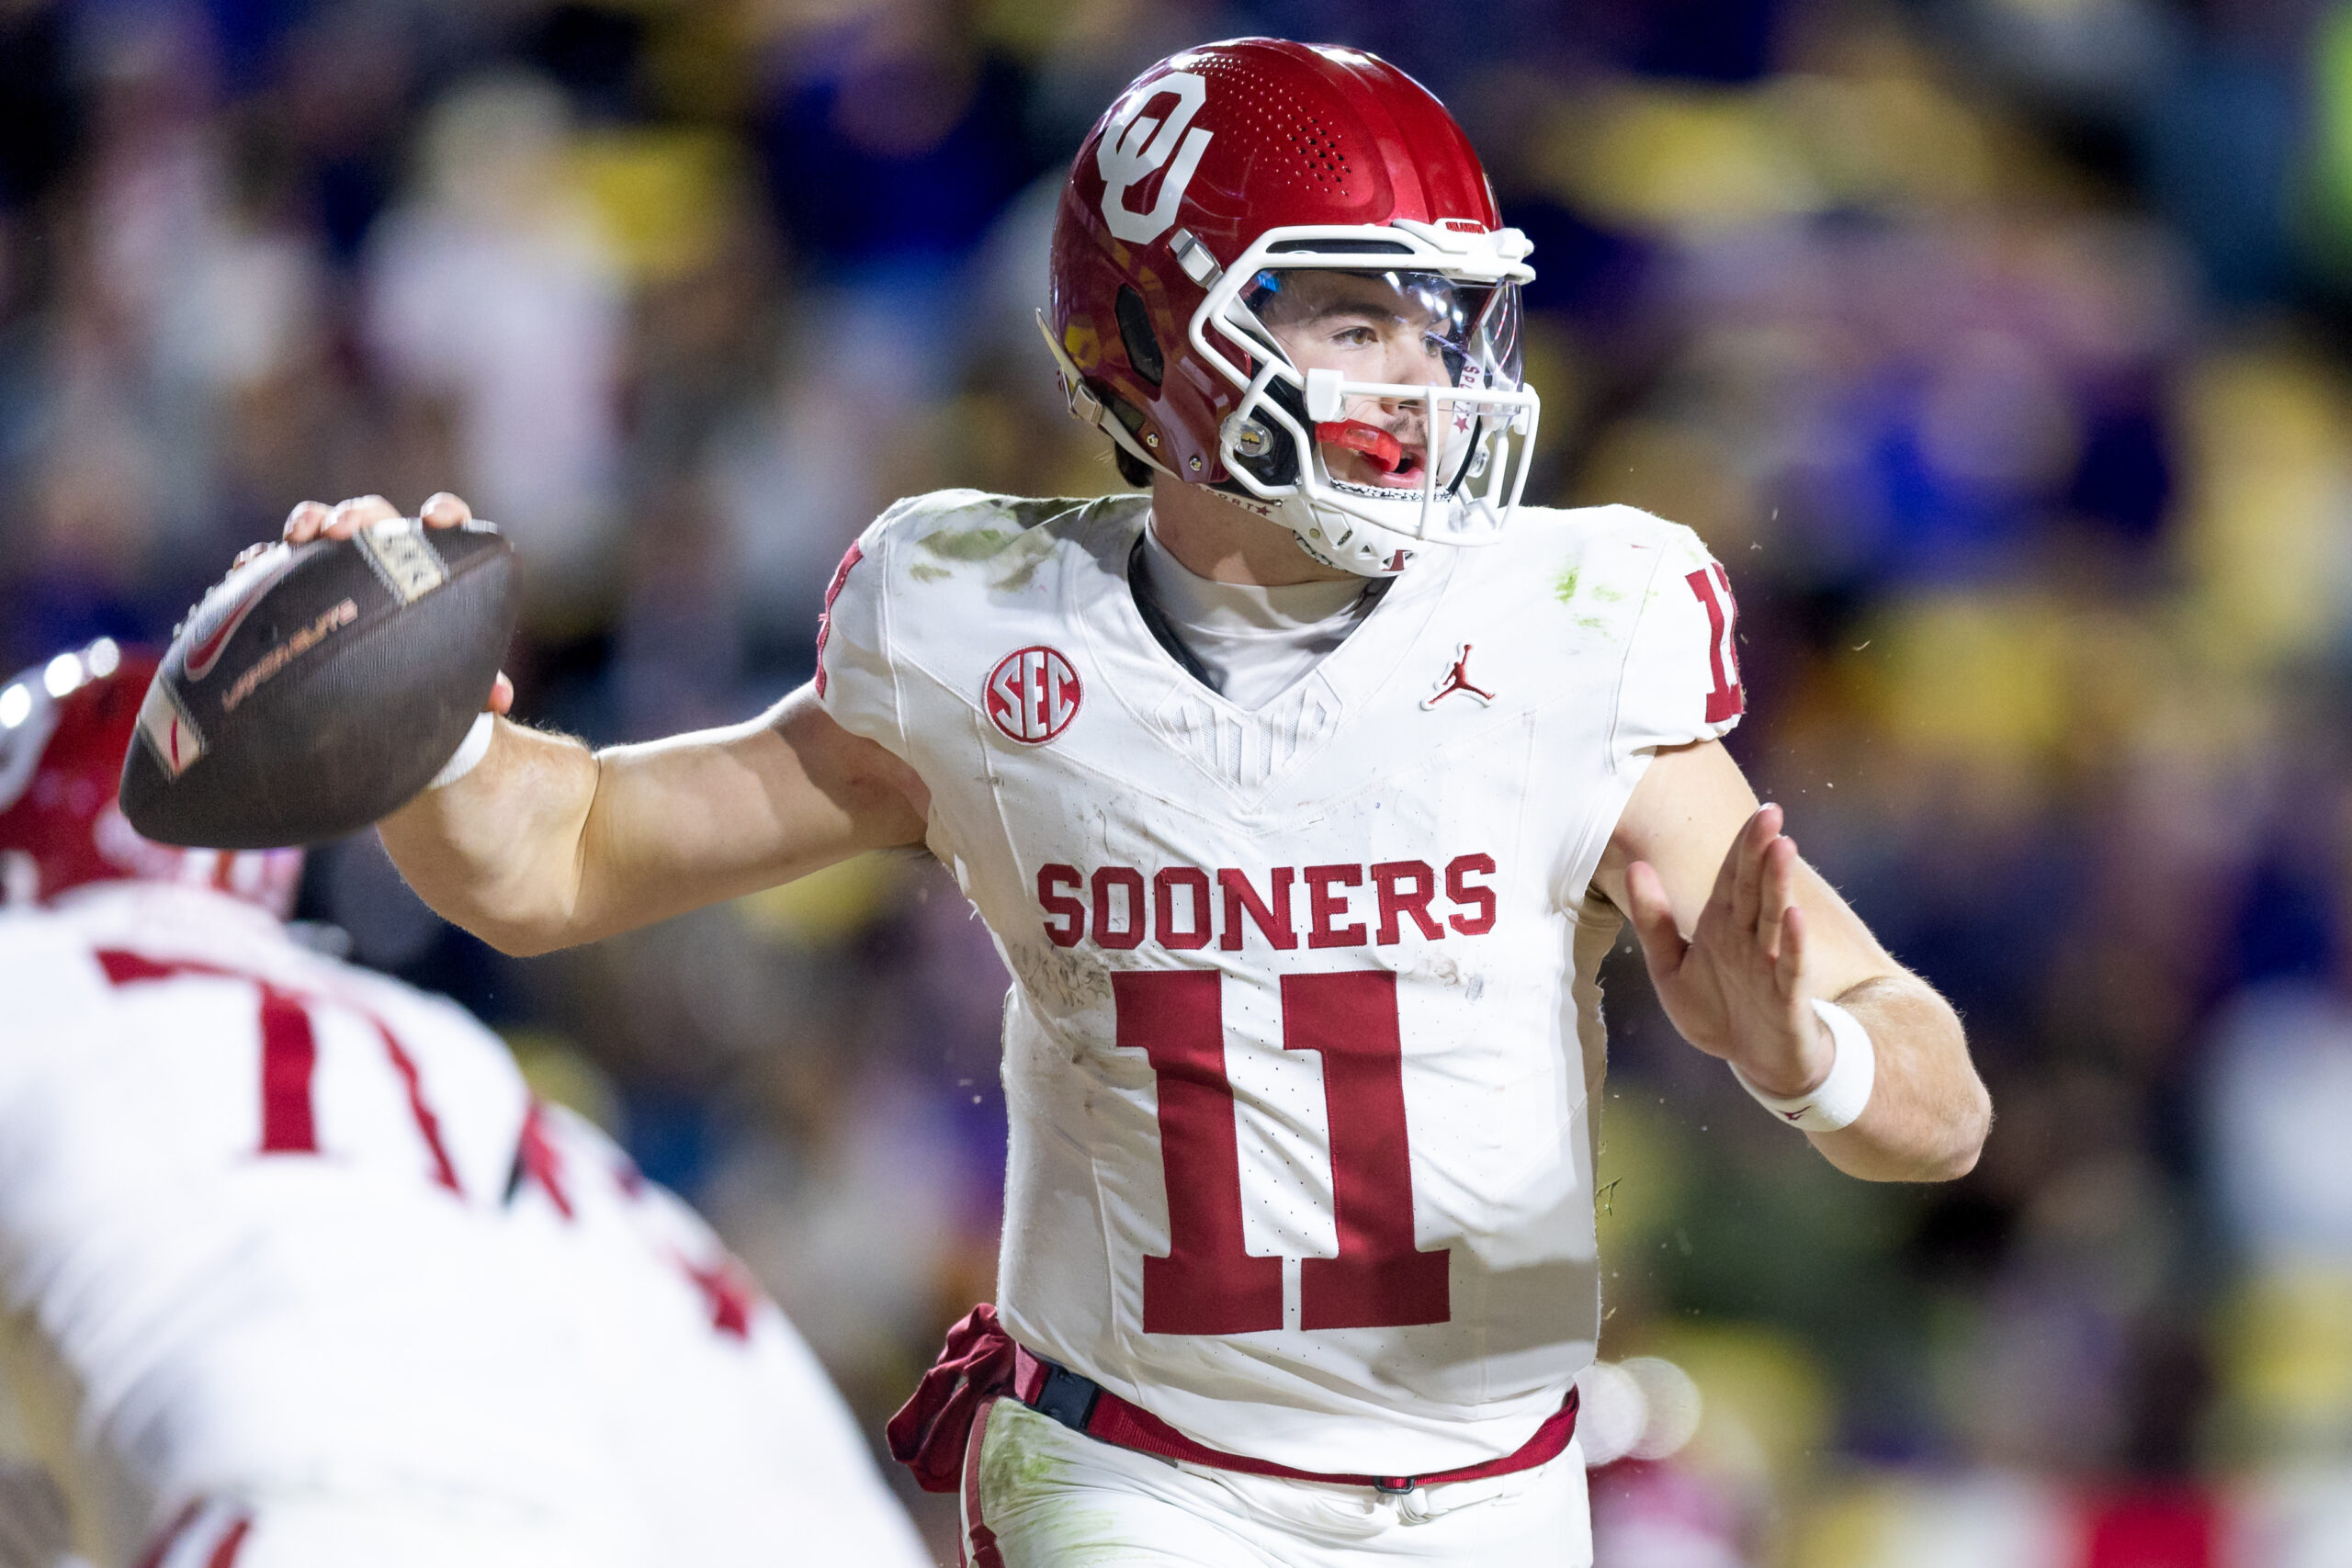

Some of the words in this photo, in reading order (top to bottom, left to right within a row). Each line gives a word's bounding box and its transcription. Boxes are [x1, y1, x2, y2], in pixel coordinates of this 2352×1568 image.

[1096, 71, 1215, 245] OU
[992, 650, 1075, 739] SEC
[1037, 852, 1497, 951] SOONERS
[1111, 969, 1451, 1335] 11
